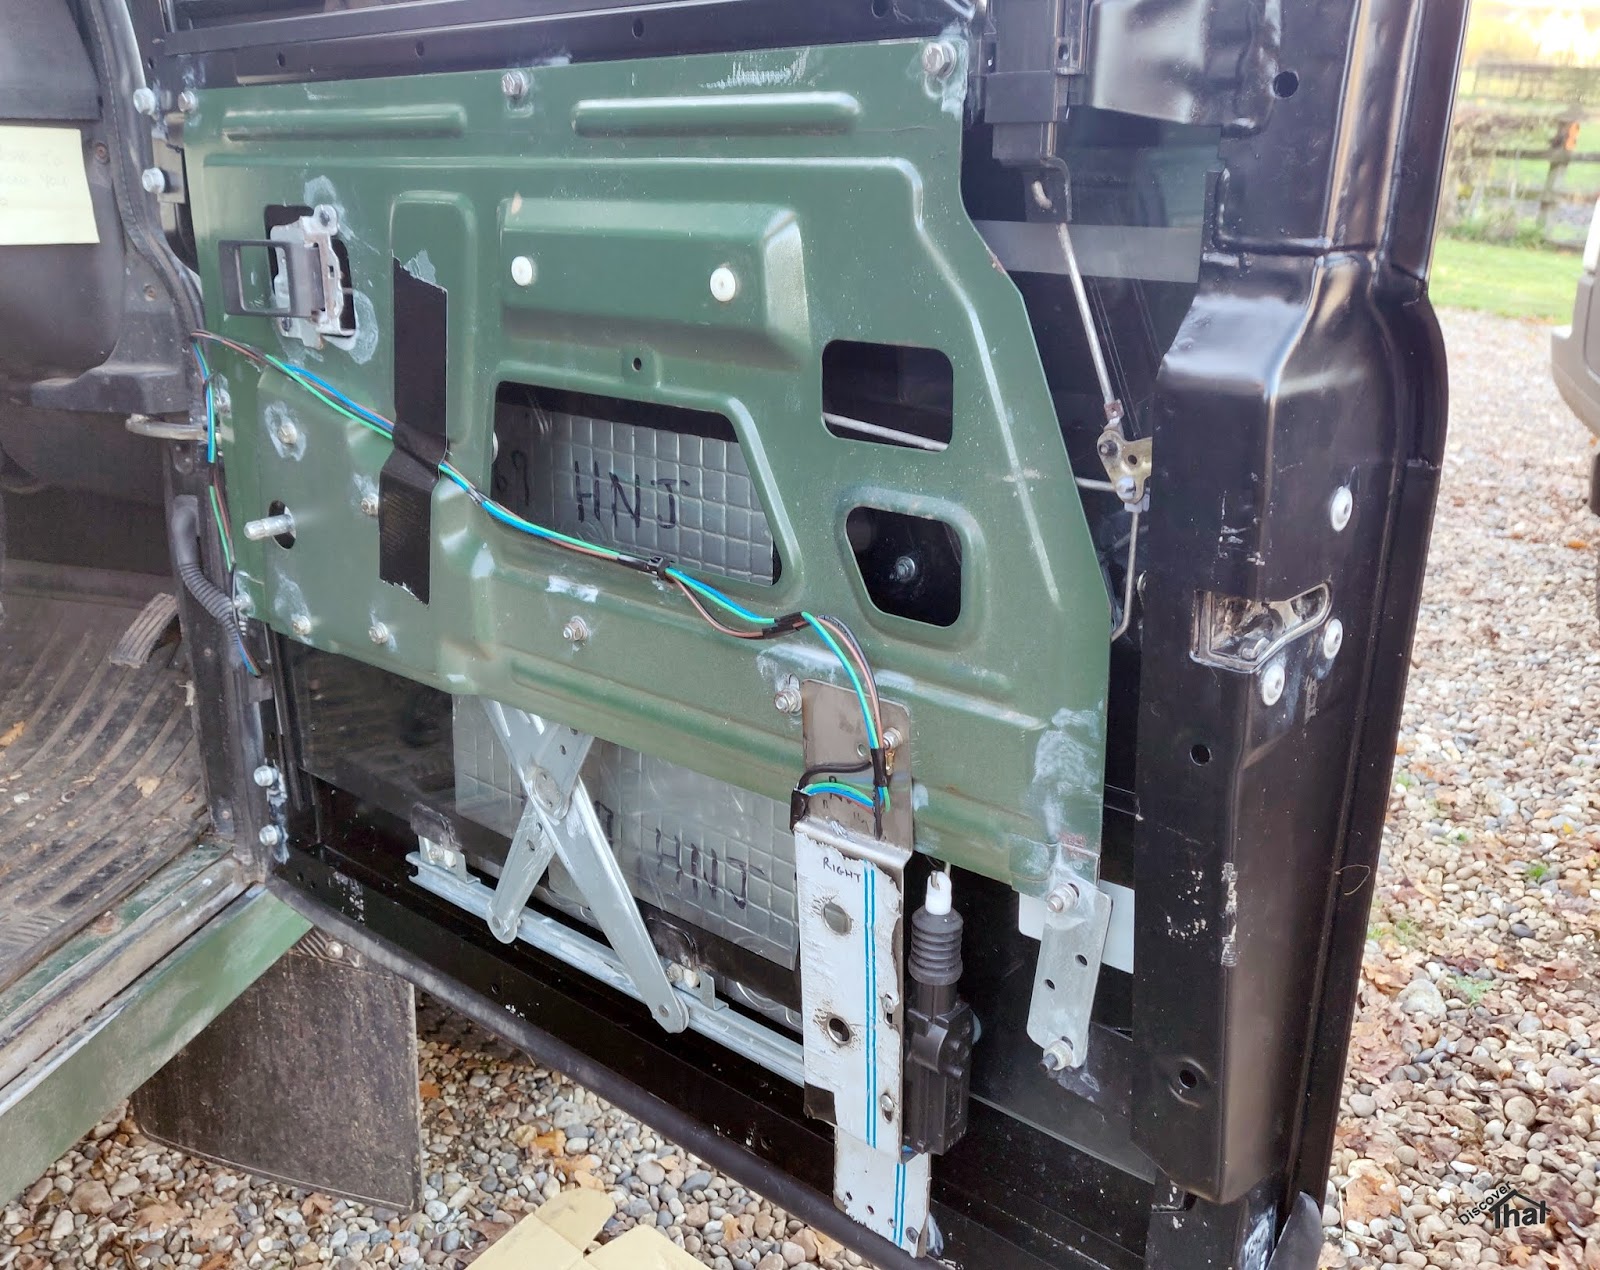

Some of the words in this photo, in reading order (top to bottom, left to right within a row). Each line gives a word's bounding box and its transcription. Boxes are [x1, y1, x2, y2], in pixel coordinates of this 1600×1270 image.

[574, 460, 690, 529] HNJ
[655, 827, 765, 910] HNJ
[823, 857, 862, 883] RIGHT
